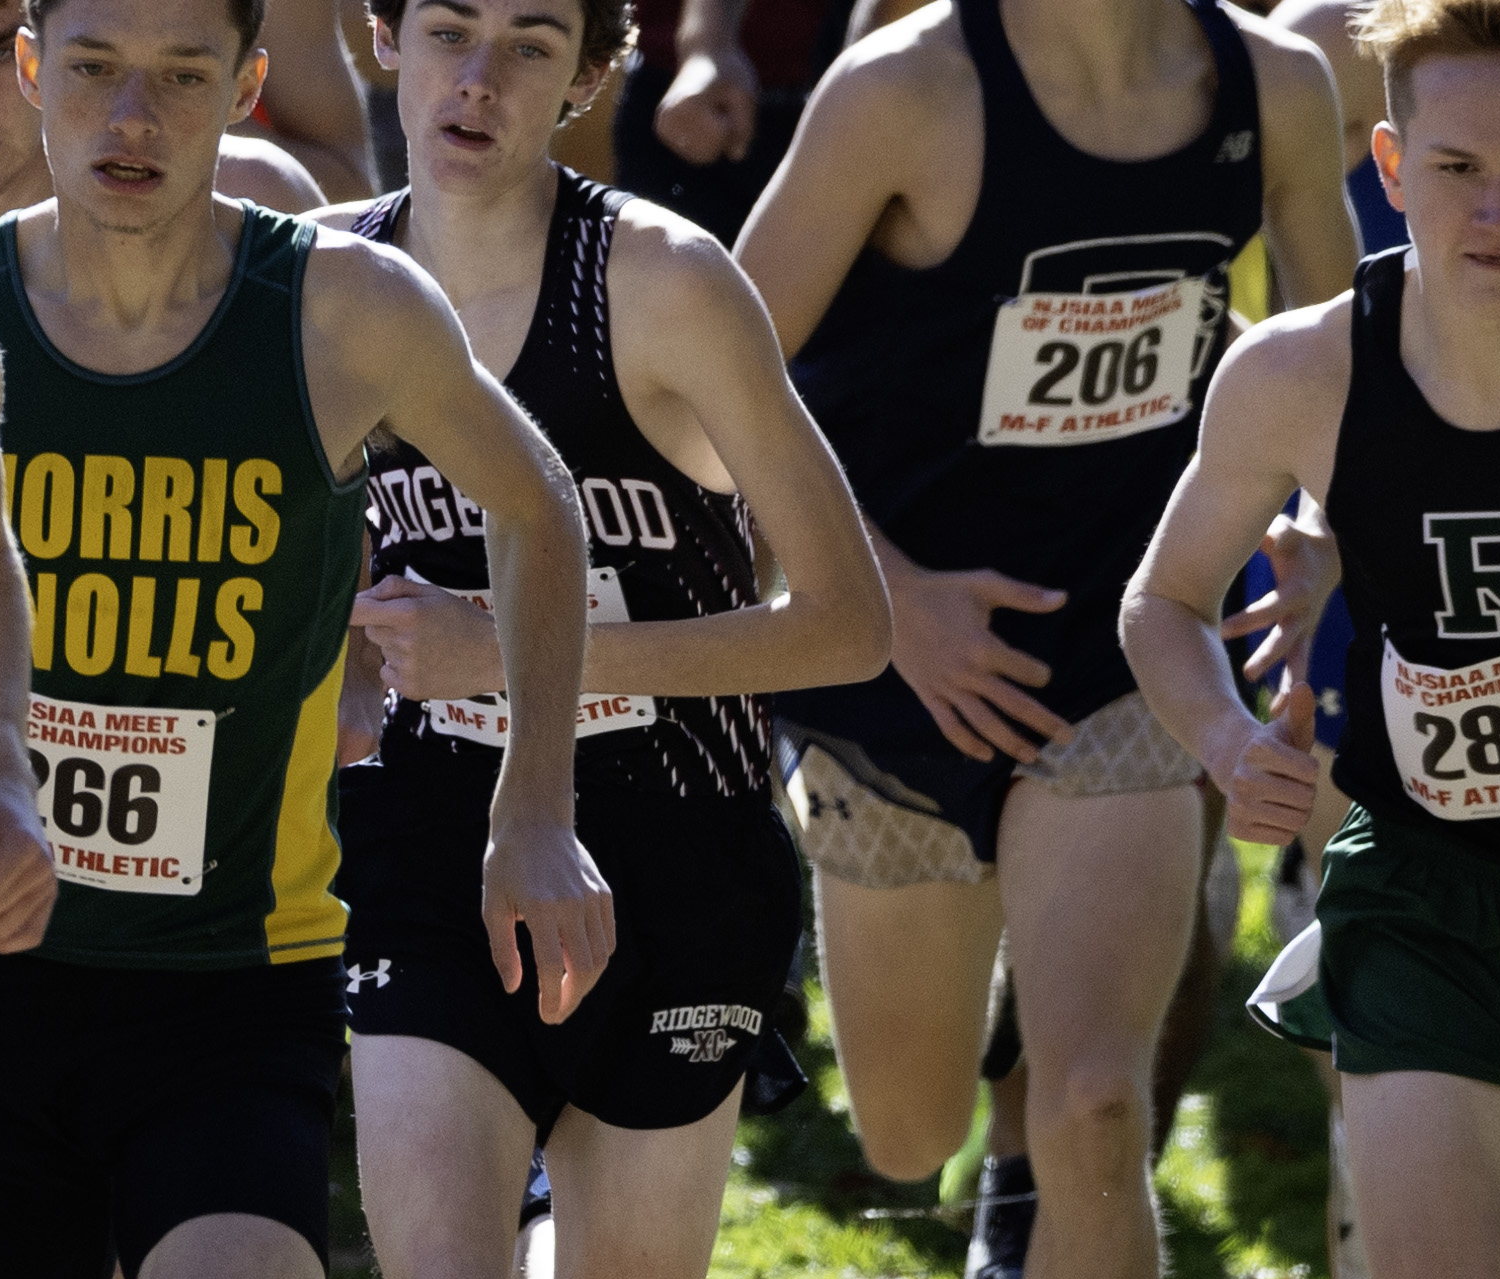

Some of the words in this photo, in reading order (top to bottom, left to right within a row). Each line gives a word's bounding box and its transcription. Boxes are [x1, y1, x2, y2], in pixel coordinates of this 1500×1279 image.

[1021, 316, 1052, 332] OF
[1057, 295, 1184, 335] CHAMPIONS
[1031, 296, 1125, 319] NJSIAA
[1027, 326, 1162, 408] 206
[999, 413, 1054, 434] M-F
[1059, 394, 1173, 434] ATHLETIC
[4, 451, 283, 565] ORRIS
[1394, 680, 1415, 700] OF
[1395, 659, 1484, 692] NJSIAA
[105, 713, 179, 734] MEET
[445, 703, 487, 733] M-F
[26, 721, 187, 755] CHAMPIONS
[1410, 776, 1453, 808] M-F
[48, 841, 180, 879] THLETIC
[649, 1004, 763, 1036] RIDGEWOOD
[688, 1028, 727, 1063] XC
